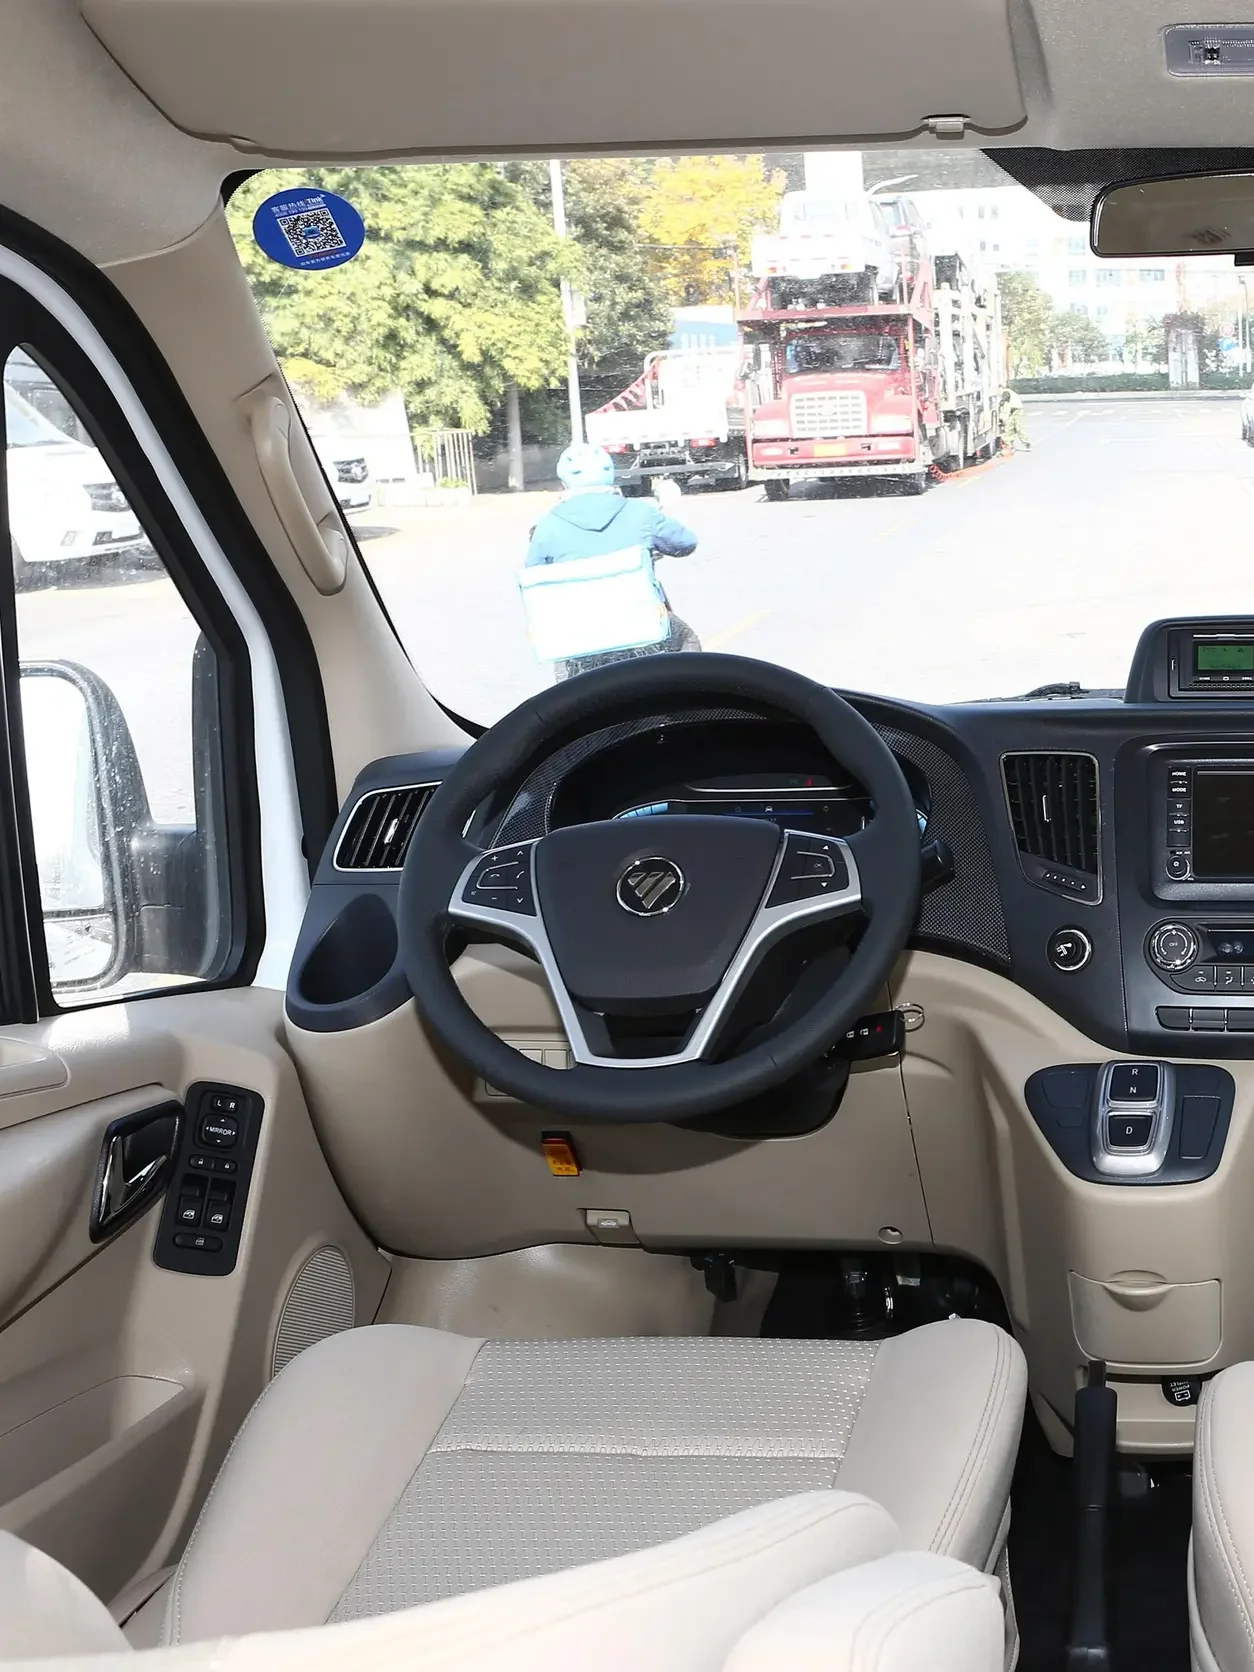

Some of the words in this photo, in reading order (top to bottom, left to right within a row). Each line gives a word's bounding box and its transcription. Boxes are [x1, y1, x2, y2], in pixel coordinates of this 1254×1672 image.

[1131, 1068, 1139, 1076] R
[1129, 1086, 1137, 1094] N
[217, 1099, 222, 1107] L
[229, 1101, 236, 1109] R
[209, 1126, 232, 1136] MIRROR
[1125, 1126, 1133, 1135] D
[1171, 1384, 1190, 1392] POWER
